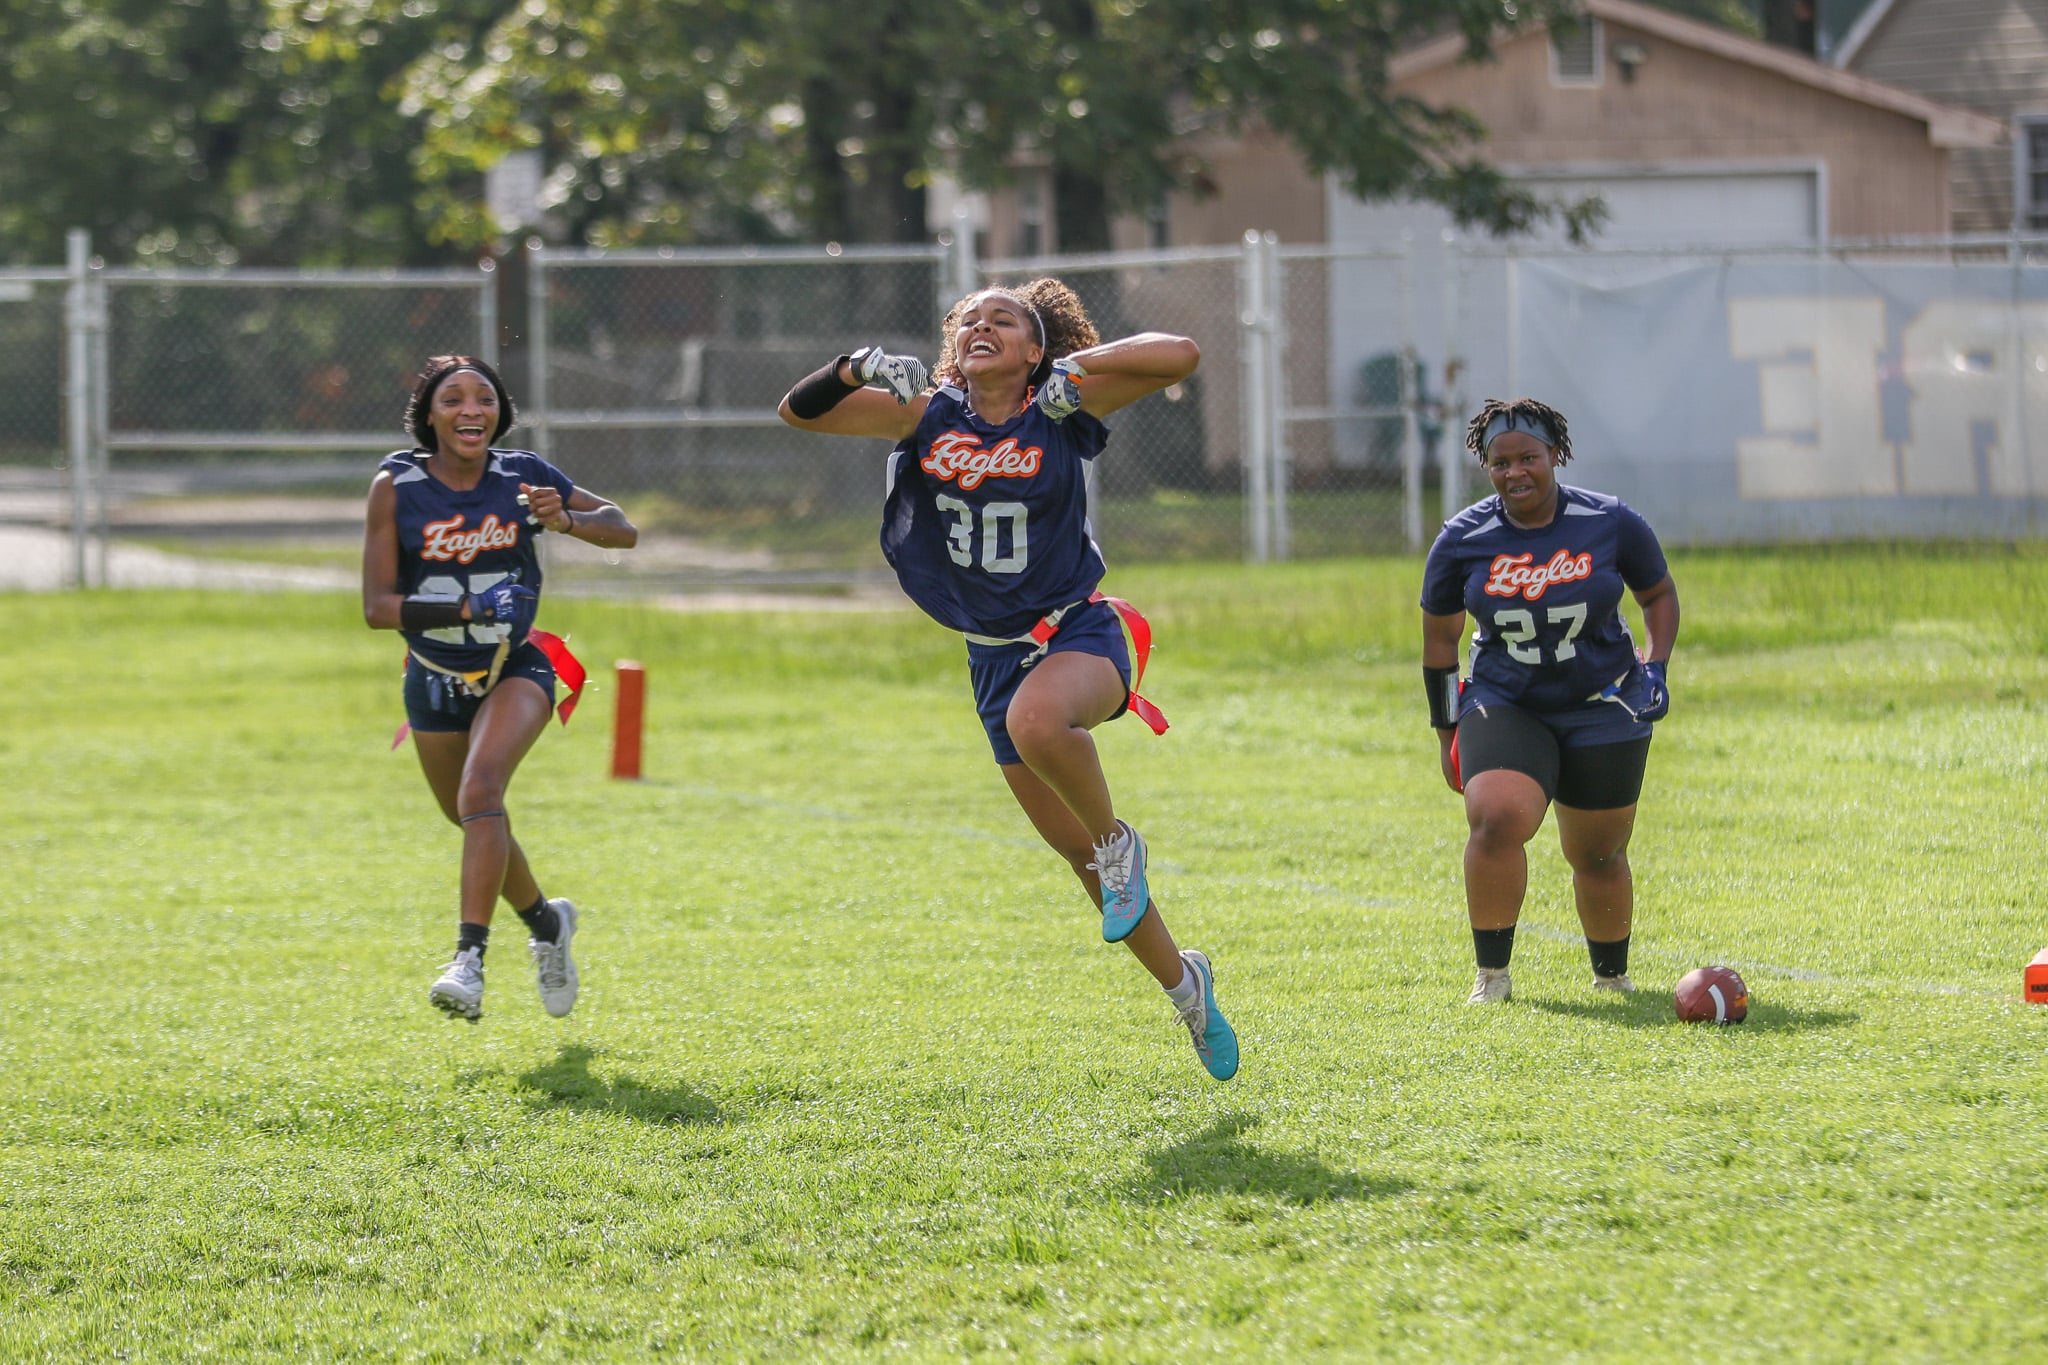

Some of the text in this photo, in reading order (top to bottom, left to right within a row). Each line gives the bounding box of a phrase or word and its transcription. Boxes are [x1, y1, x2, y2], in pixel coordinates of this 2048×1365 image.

[920, 430, 1043, 491] Eagles
[421, 514, 518, 564] Eagles
[936, 493, 1028, 573] 30
[1484, 549, 1592, 601] Eagles
[1493, 602, 1587, 664] 27
